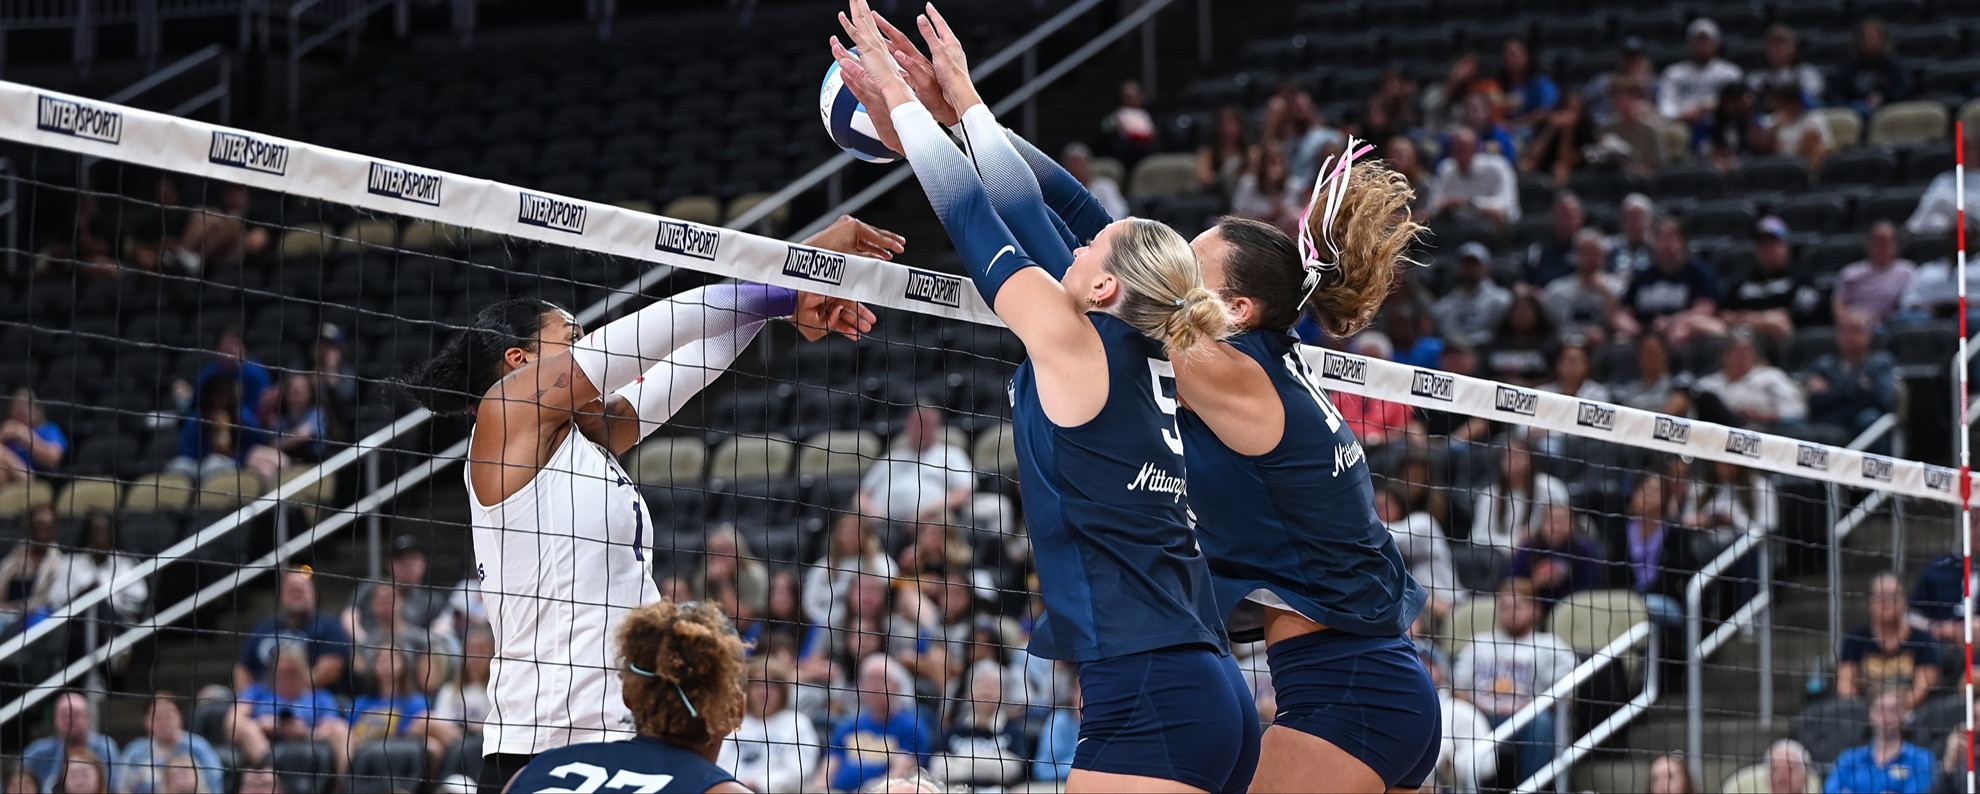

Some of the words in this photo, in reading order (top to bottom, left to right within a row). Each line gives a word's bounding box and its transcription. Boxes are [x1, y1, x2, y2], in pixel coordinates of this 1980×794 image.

[40, 96, 119, 141] INTERSPORT
[212, 132, 286, 172] INTERSPORT
[371, 162, 440, 202] INTERSPORT
[520, 193, 583, 231] INTERSPORT
[658, 222, 718, 258] INTERSPORT
[786, 248, 844, 281] INTERSPORT
[908, 271, 960, 304] INTERSPORT
[1323, 353, 1365, 382] INTERSPORT
[1148, 358, 1184, 456] 5
[532, 761, 674, 793] 27
